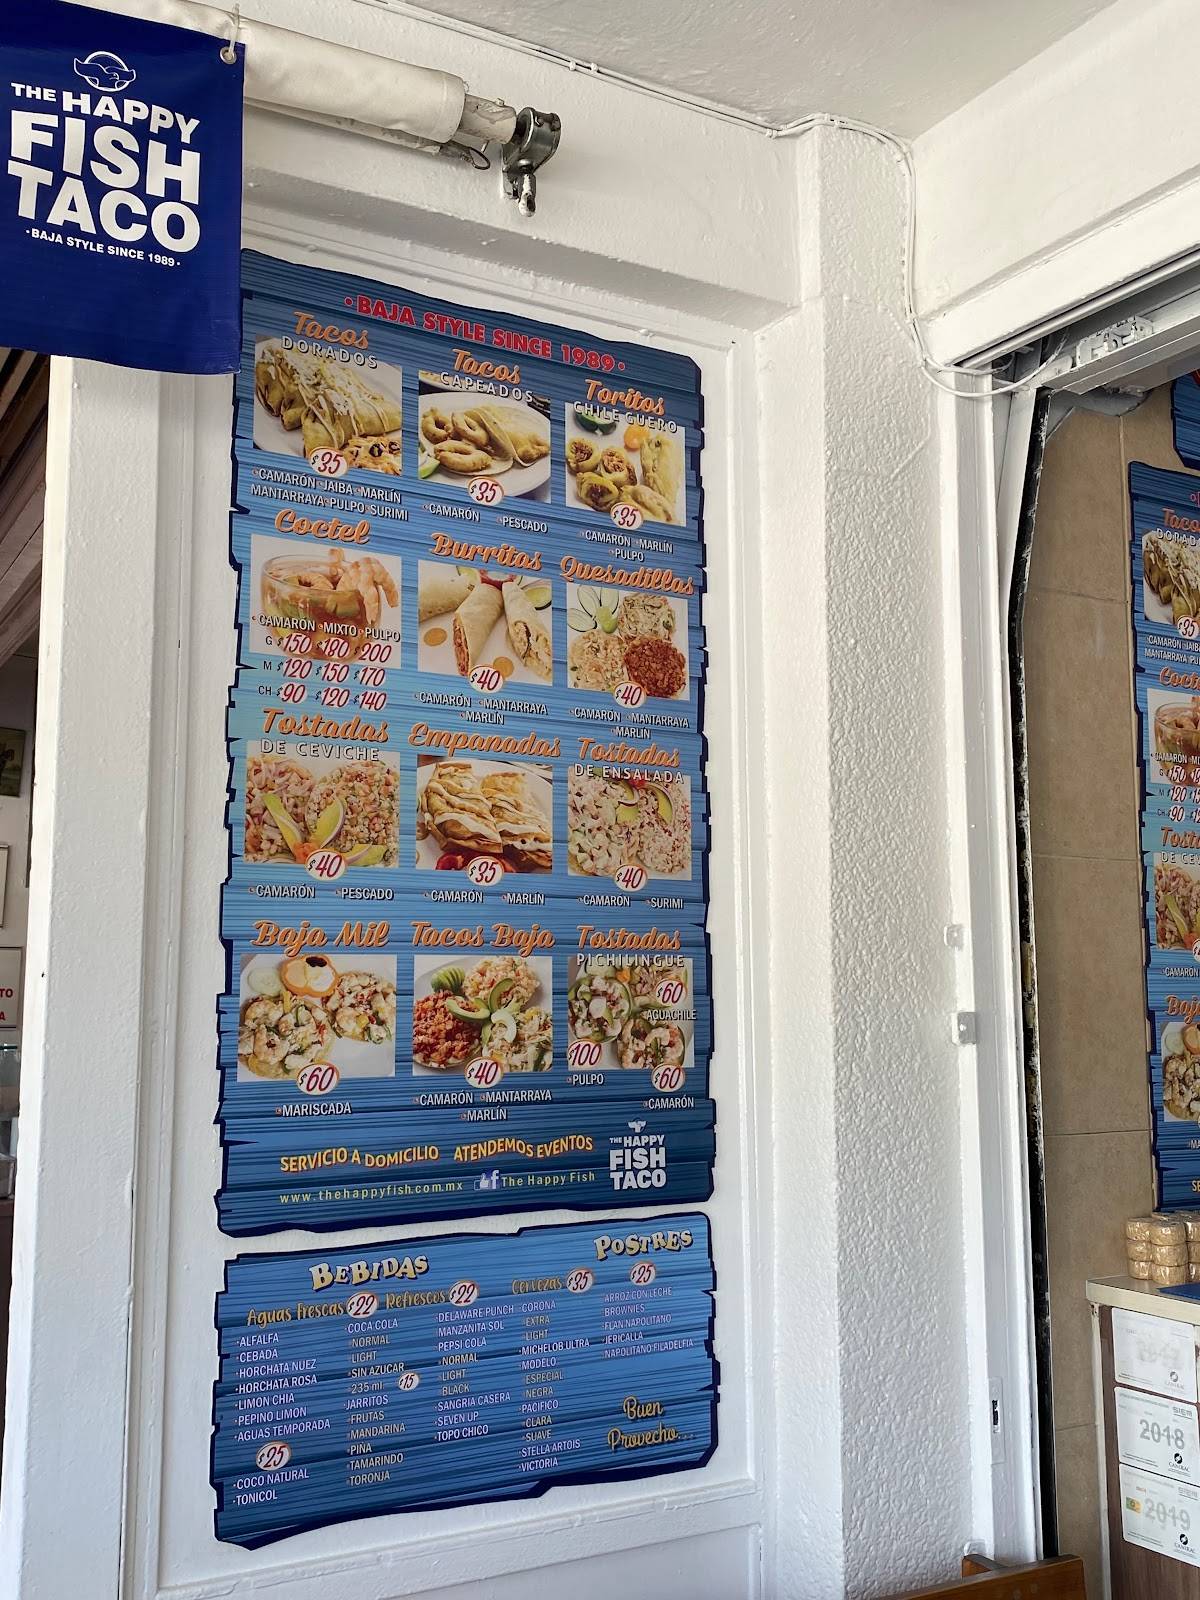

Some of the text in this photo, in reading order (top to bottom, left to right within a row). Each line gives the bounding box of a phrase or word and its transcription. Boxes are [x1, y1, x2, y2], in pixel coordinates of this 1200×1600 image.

[11, 82, 200, 145] THE HAPPY
[10, 109, 201, 206] FISH
[7, 159, 201, 253] TACO
[31, 227, 176, 267] BAJA STYLE SINCE 1989
[293, 311, 369, 350] Tacos
[356, 295, 616, 371] BAJA STYLE SINCE 1989
[281, 335, 378, 369] DORADOS
[452, 348, 521, 386] Tacos
[440, 371, 533, 404] CAPEADOS
[584, 377, 666, 416] Toritos
[573, 400, 679, 434] CHILE GUERO
[311, 451, 344, 475] $35
[258, 468, 402, 505] CAMARÓN JAIBA MARLÍN
[469, 480, 499, 504] $35
[251, 483, 409, 522] MANTARRAYA PULPO SURIMI
[274, 508, 371, 545] Coctel
[429, 503, 548, 534] CAMARÓN PESCADO
[1161, 508, 1200, 532] Taco
[429, 532, 542, 573] Burritos
[585, 529, 674, 554] CAMARÓN MARLÍN
[614, 547, 645, 563] PULPO
[559, 555, 695, 597] Quesadillas
[258, 613, 401, 642] CAMARÓN MIXTO PULPO
[265, 635, 274, 646] G
[263, 659, 273, 672] M
[258, 684, 273, 697] CH
[418, 690, 549, 716] CAMARÓN MANTARRAYA
[262, 706, 390, 744] Tostadas
[465, 709, 504, 726] MARLÍN
[631, 712, 690, 729] MANTARRAYA
[260, 738, 380, 762] DE CEVICHE
[408, 722, 561, 757] Empanadas
[577, 736, 680, 769] Tostadas
[574, 763, 685, 785] DE ENSALADA
[255, 882, 395, 901] CAMARÓN PESCADO
[430, 888, 546, 906] CAMARÓN MARLÍN
[650, 896, 684, 910] SURIMI
[251, 920, 391, 957] Baja Mil
[410, 921, 556, 959] Tacos Baja
[576, 925, 682, 950] Tostadas
[576, 953, 685, 968] PICHILINGUE
[646, 1009, 698, 1022] AGUACHILE
[572, 1073, 605, 1087] PULPO
[419, 1088, 553, 1106] CAMARÓN MANTARRAYA
[648, 1096, 695, 1111] CAMARÓN
[282, 1101, 352, 1118] MARISCADA
[466, 1108, 508, 1123] MARLÍN
[453, 1134, 594, 1164] ATENDEMOS EVENTOS
[609, 1134, 666, 1149] THE HAPPY
[279, 1144, 440, 1173] SERVICIO A DOMICILIO
[609, 1147, 667, 1172] FISH
[502, 1170, 596, 1188] The Happy Fish
[609, 1168, 668, 1191] TACO
[279, 1180, 464, 1204] www.thehappyfish.com.mx
[593, 1229, 695, 1262] POSTRES
[309, 1254, 430, 1292] BEBIDAS
[386, 1290, 447, 1311] Refrescos
[247, 1307, 293, 1330] Aguas
[347, 1318, 399, 1334] COCA COLA
[239, 1333, 280, 1348] ALFALFA
[521, 1338, 590, 1356] MICHELOB ULTRA
[239, 1348, 279, 1364] CEBADA
[239, 1358, 318, 1379] HORCHATA NUEZ
[350, 1362, 406, 1379] SIN AZUCAR
[238, 1374, 318, 1395] HORCHATA ROSA
[238, 1392, 296, 1411] LIMON CHIA
[346, 1395, 390, 1411] JARRITOS
[622, 1396, 664, 1420] Buen
[238, 1406, 308, 1427] PEPINO LIMON
[237, 1418, 331, 1443] AGUAS TEMPORADA
[437, 1425, 490, 1442] TOPO CHICO
[1139, 1418, 1186, 1451] 2018
[350, 1442, 373, 1456] PIÑA
[236, 1468, 310, 1490] COCO NATURAL
[236, 1490, 279, 1507] TONICOL
